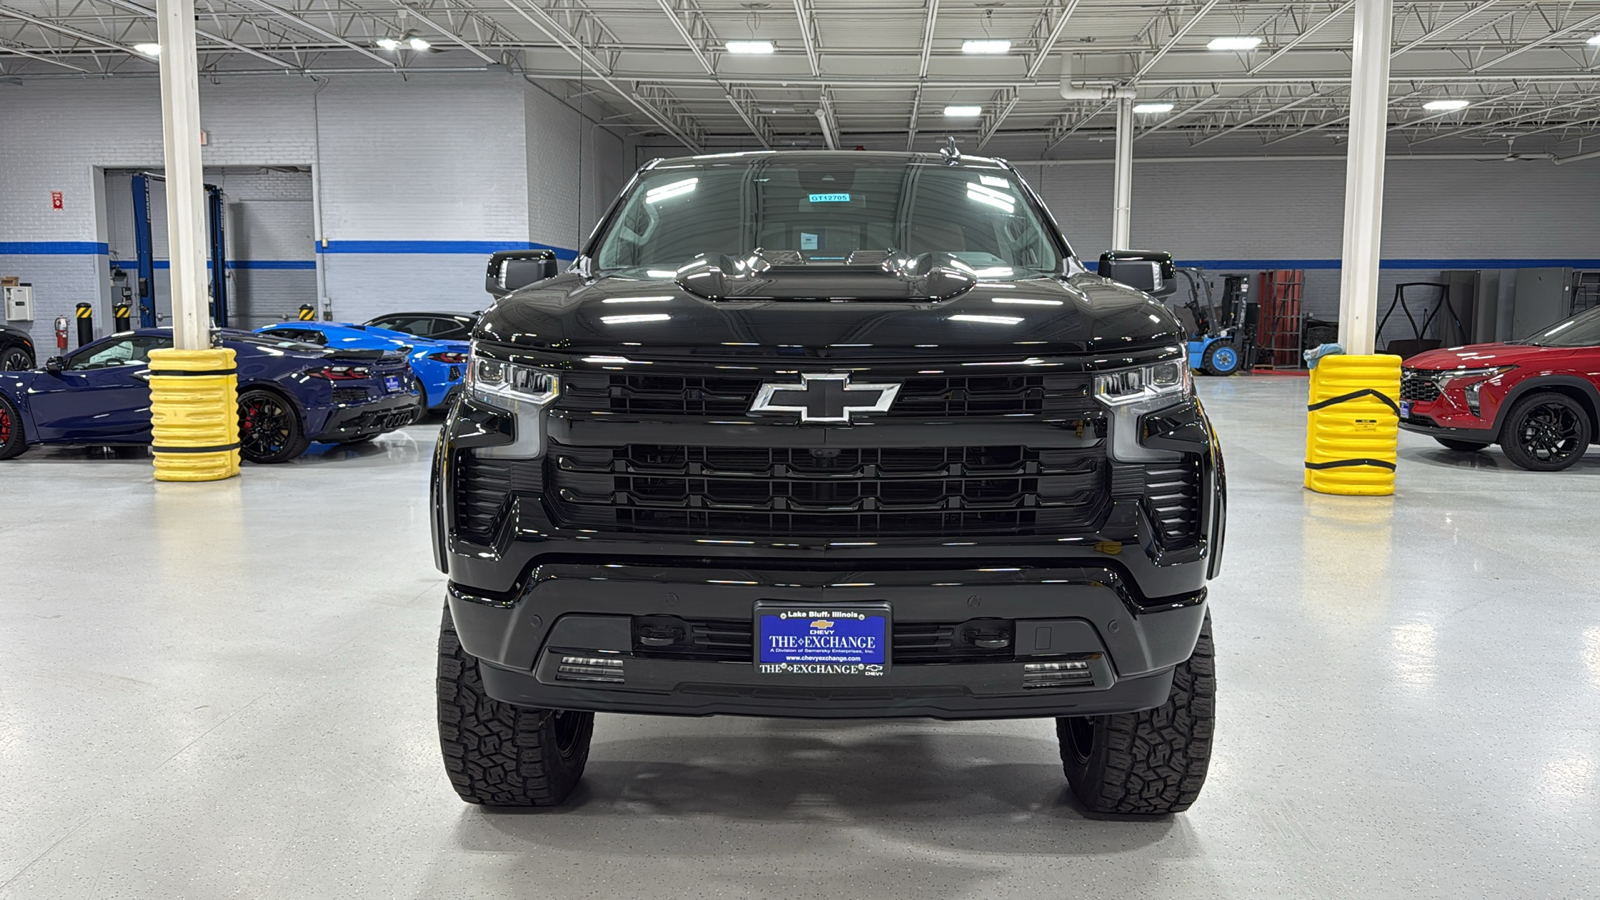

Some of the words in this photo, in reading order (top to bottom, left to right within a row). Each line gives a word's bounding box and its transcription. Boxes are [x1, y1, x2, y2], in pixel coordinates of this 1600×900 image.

[769, 636, 798, 648] THE
[804, 636, 876, 649] EXCHANGE
[759, 664, 783, 674] THE
[793, 664, 859, 674] EXCHANGE
